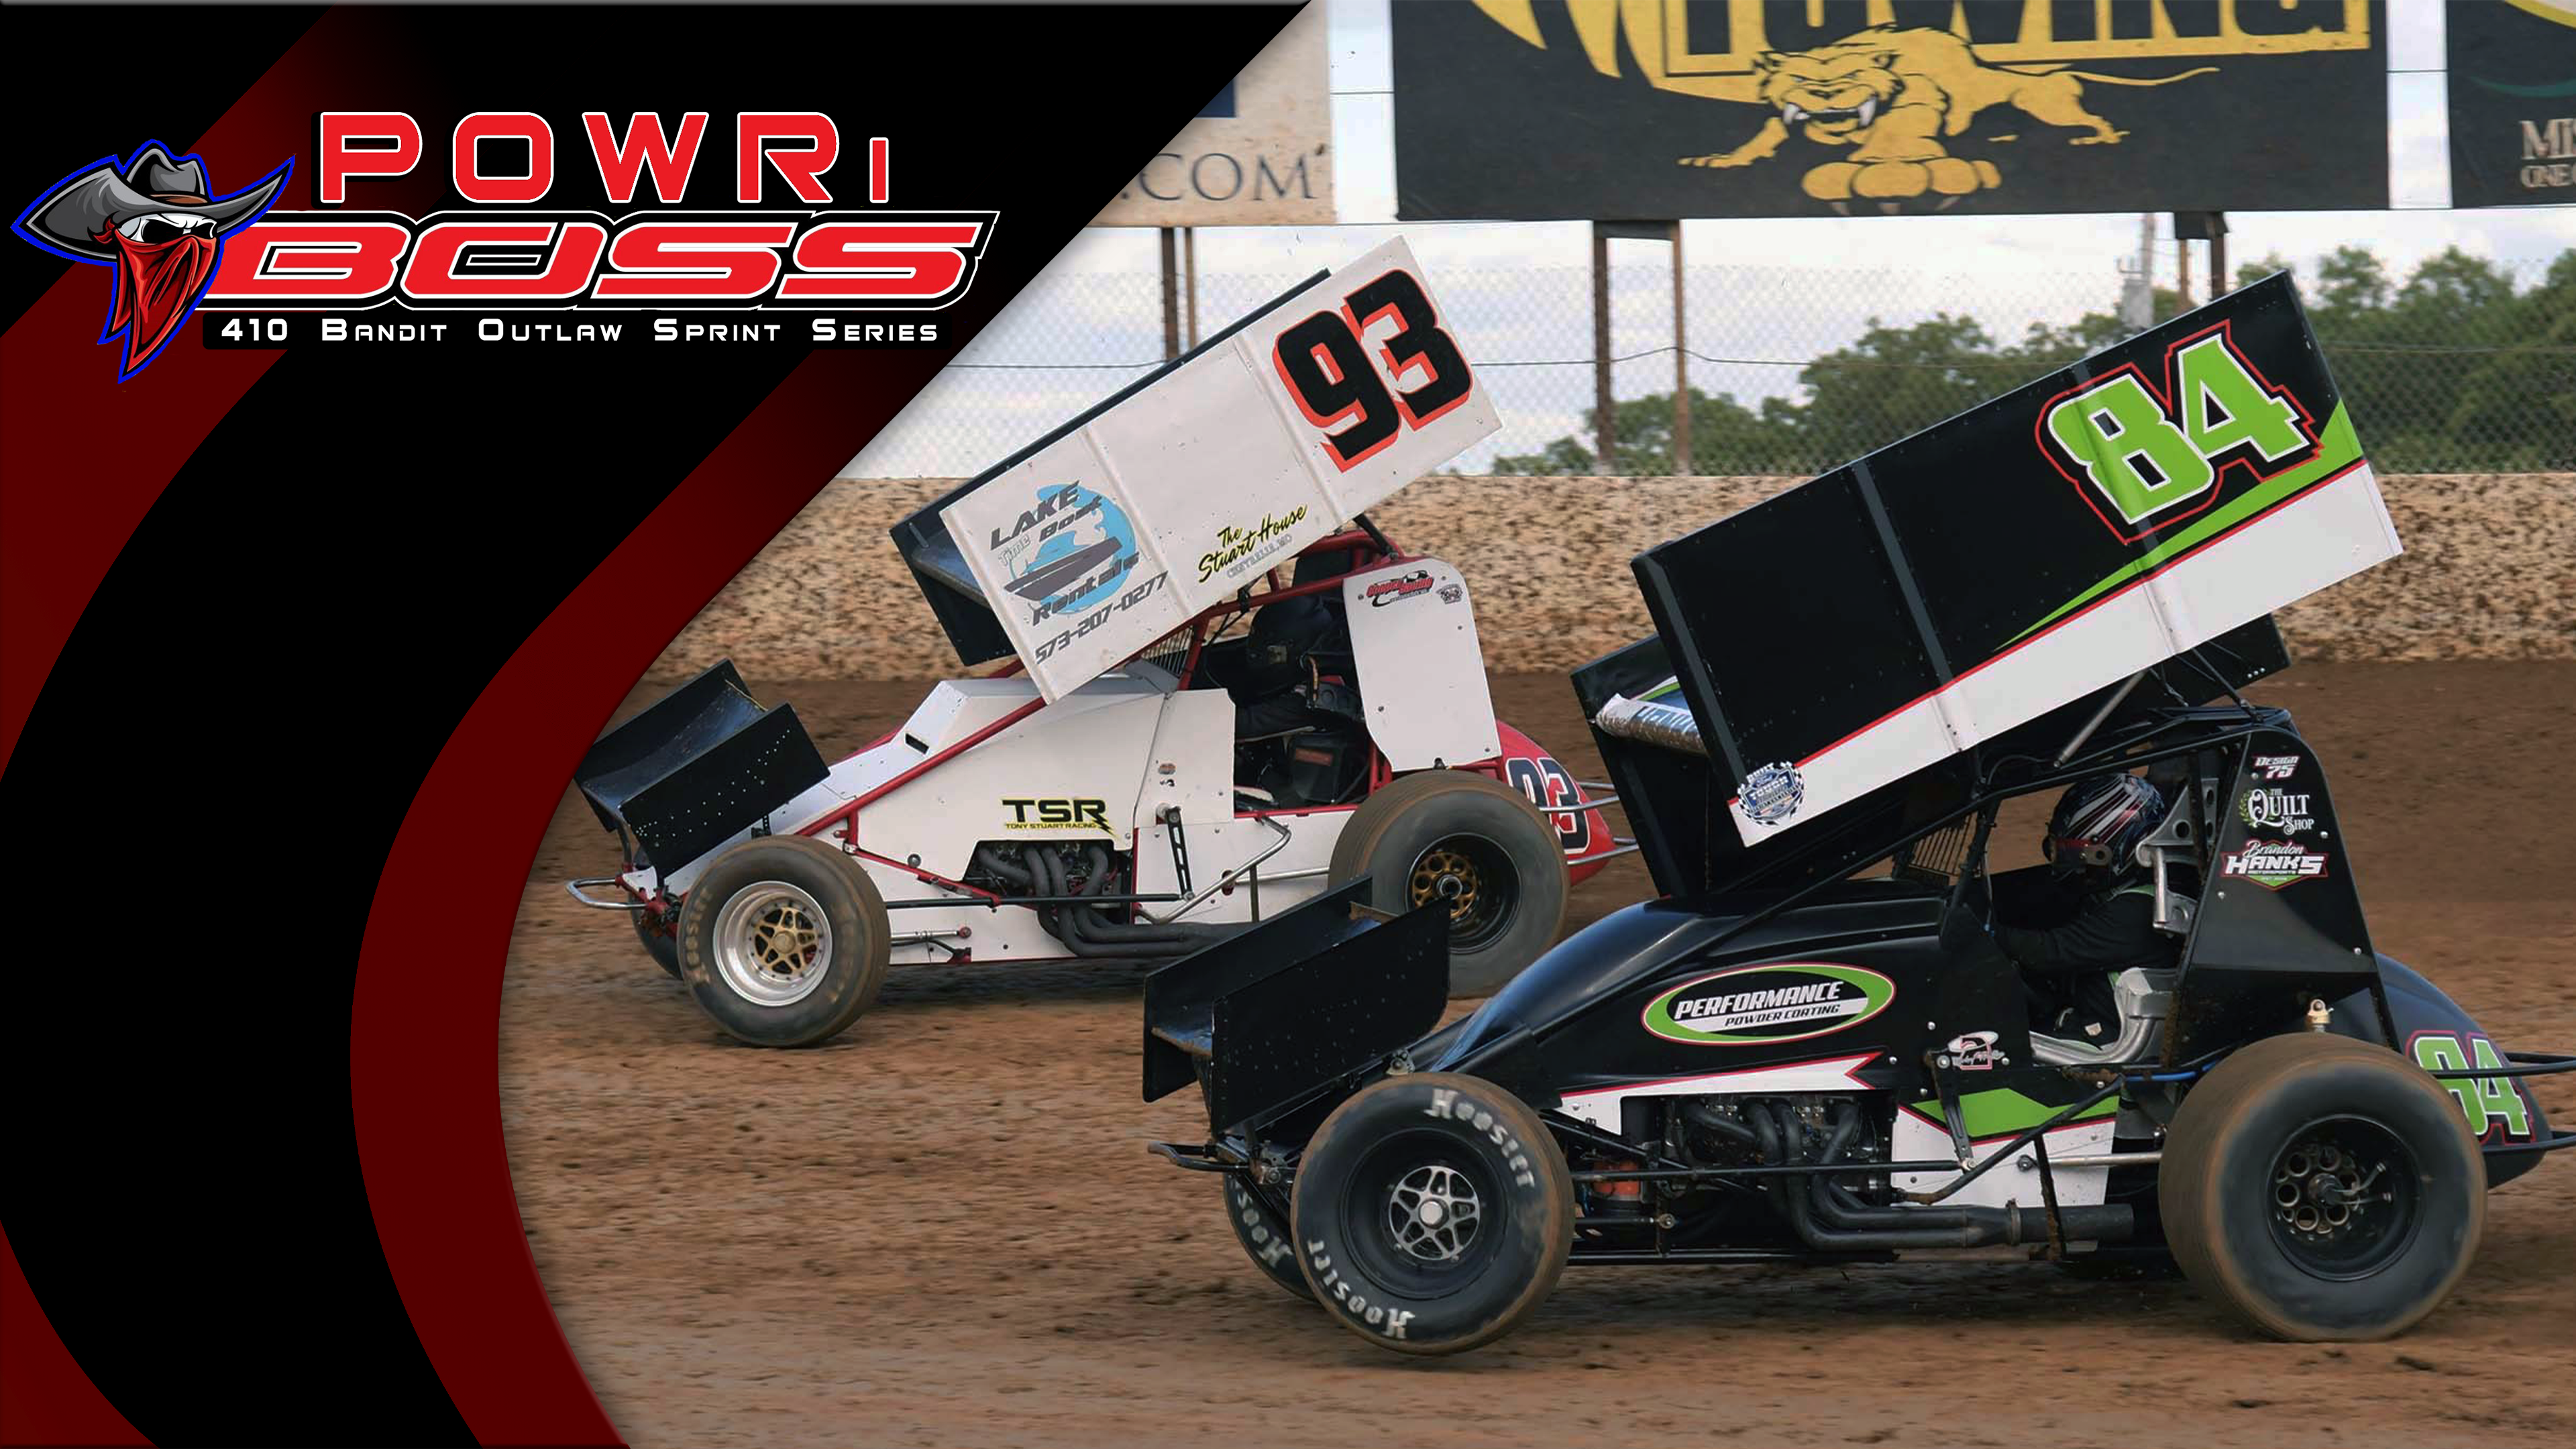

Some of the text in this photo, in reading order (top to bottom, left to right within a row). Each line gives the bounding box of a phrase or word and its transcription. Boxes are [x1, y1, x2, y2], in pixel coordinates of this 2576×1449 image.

[2519, 117, 2576, 160] MI
[1272, 268, 1474, 474] 93
[2046, 332, 2312, 525] 84
[990, 480, 1081, 551] LAKE
[1197, 530, 1257, 584] Stuart
[1256, 504, 1308, 543] House
[1216, 526, 1244, 549] The
[1032, 551, 1140, 627] Rentals
[1034, 570, 1169, 665] 573-207-0277
[2265, 764, 2296, 780] 75
[1002, 799, 1115, 836] TSR
[2248, 788, 2310, 828] QUILT
[2284, 816, 2314, 835] SHOP
[2225, 855, 2326, 874] HANKS
[2243, 839, 2306, 858] Brandon
[1674, 981, 1845, 1020] PERFORMANCE
[1724, 1004, 1840, 1027] POWDER COATING
